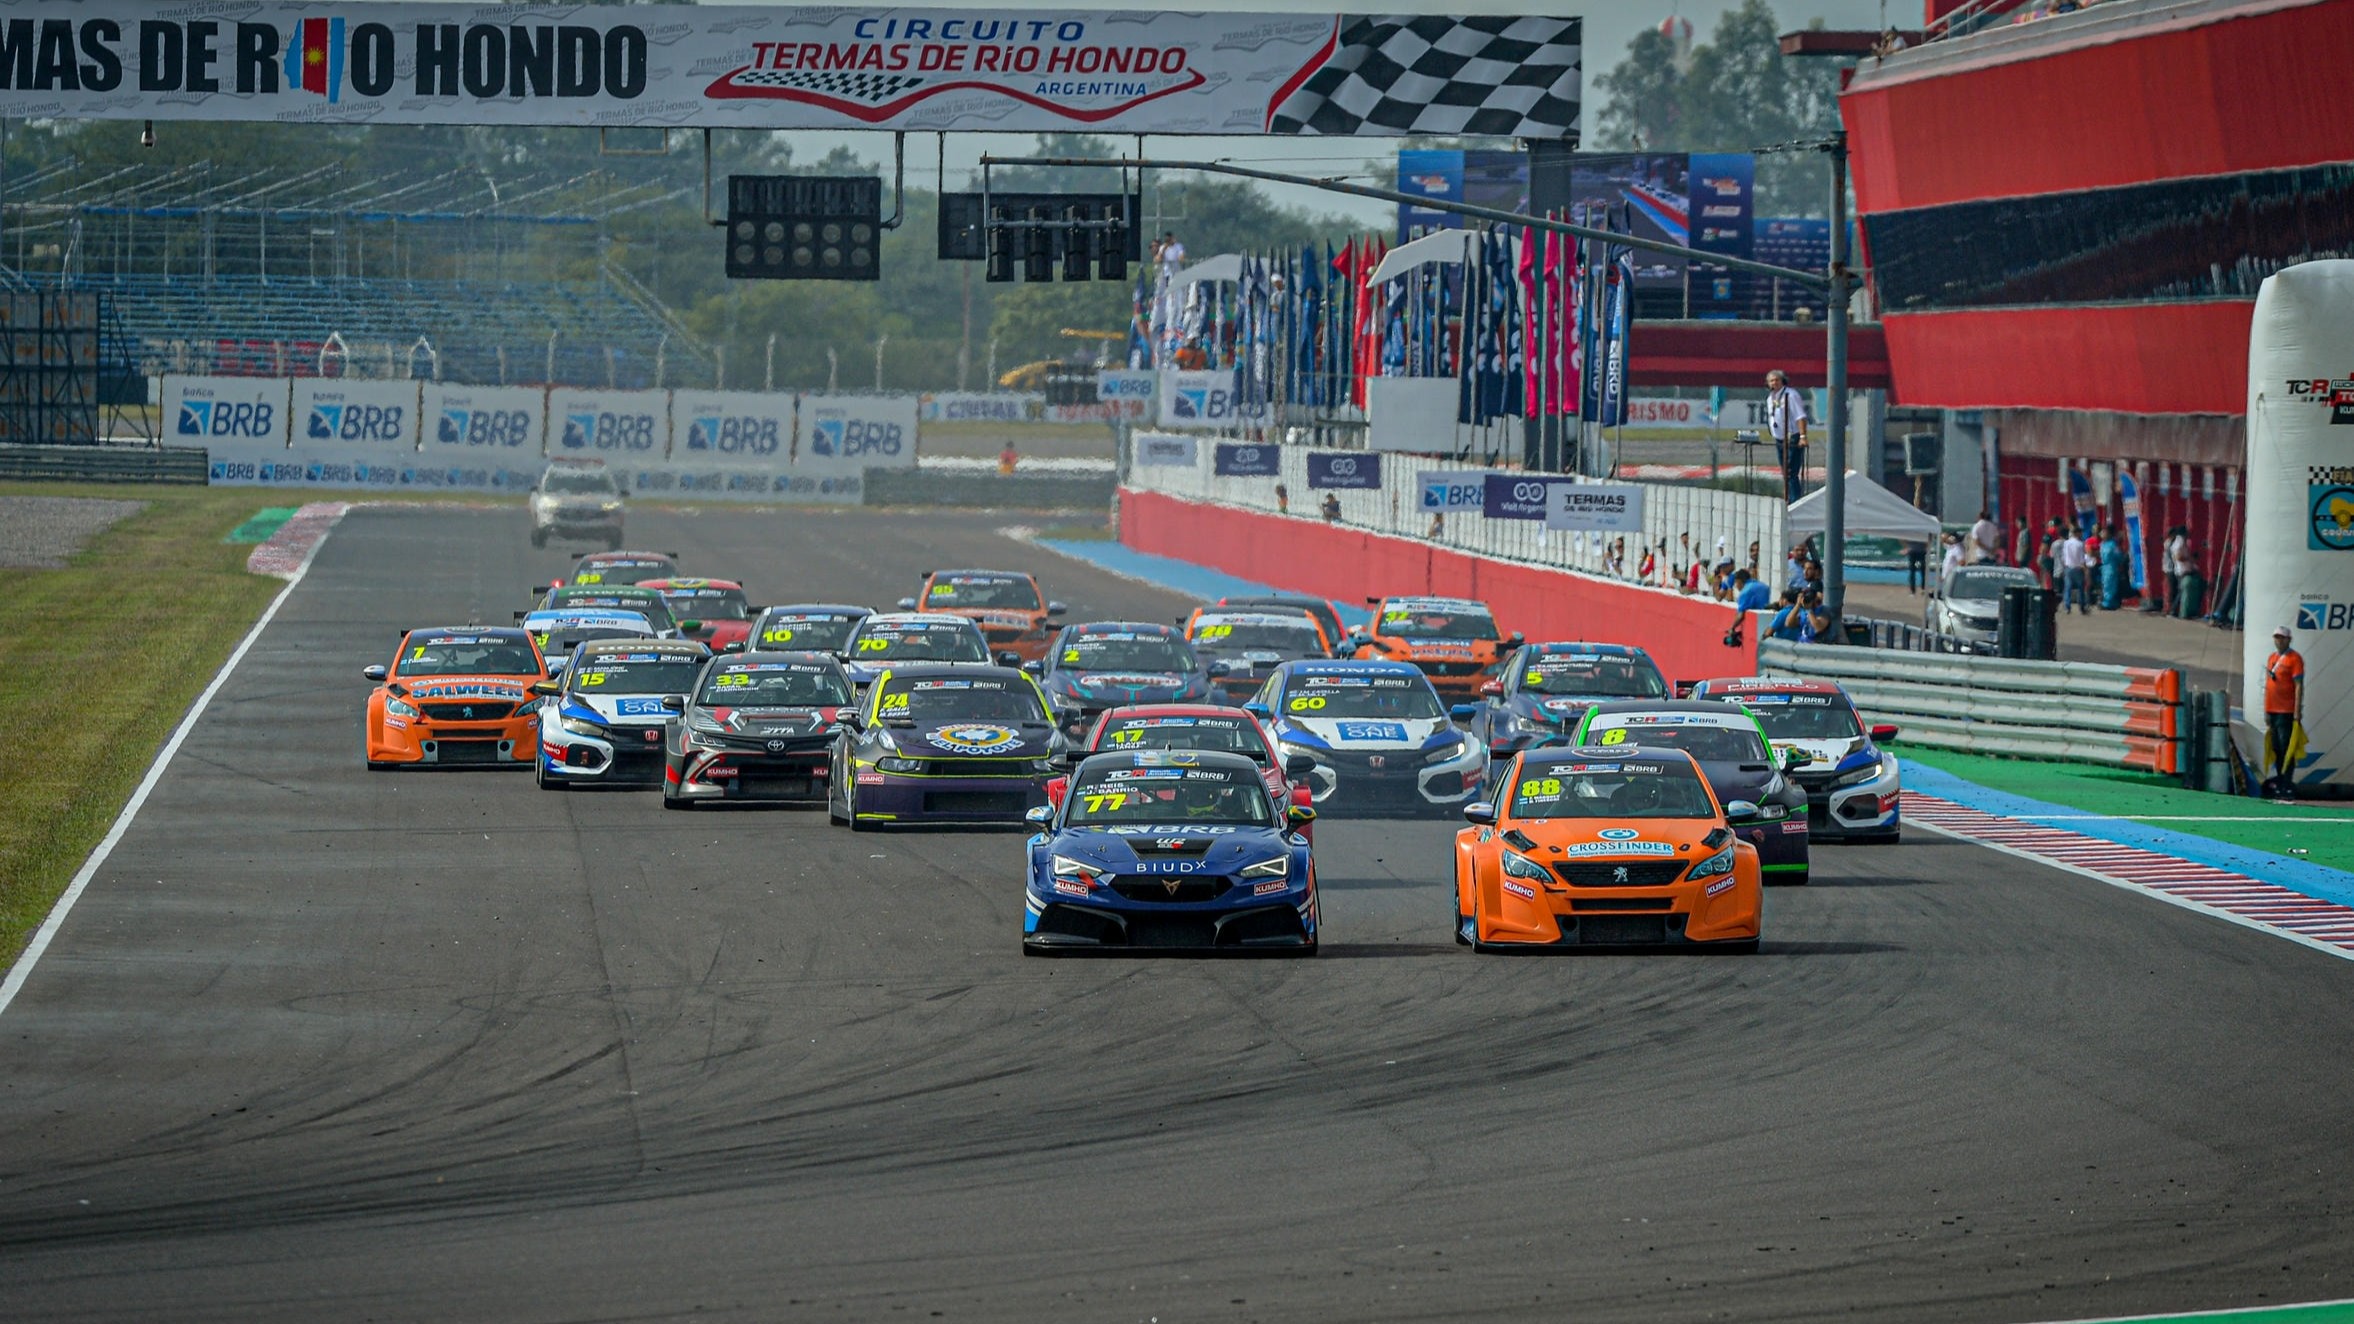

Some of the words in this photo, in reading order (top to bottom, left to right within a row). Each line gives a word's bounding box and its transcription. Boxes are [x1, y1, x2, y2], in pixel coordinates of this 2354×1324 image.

[854, 18, 1085, 41] CIRCUITO
[139, 19, 219, 93] DE
[416, 23, 648, 99] HONDO
[751, 42, 911, 72] TERMAS
[916, 44, 969, 73] DE
[1046, 46, 1187, 75] HONDO
[1034, 80, 1148, 97] ARGENTINA
[2286, 379, 2330, 395] TCR
[211, 402, 275, 437] BRB
[340, 404, 403, 441] BRB
[466, 408, 531, 447] BRB
[595, 411, 656, 450] BRB
[718, 415, 780, 455] BRB
[842, 418, 903, 458] BRB
[225, 463, 255, 480] BRB
[1564, 493, 1627, 507] TERMAS
[762, 630, 793, 643] 10
[857, 639, 889, 652] 70
[1063, 649, 1080, 663] 2
[580, 672, 606, 687] 15
[715, 673, 750, 687] 33
[1526, 671, 1543, 685] 5
[882, 692, 909, 709] 24
[1290, 696, 1327, 711] 60
[1110, 728, 1145, 744] 17
[1601, 728, 1628, 746] 8
[706, 768, 738, 776] KUMHO
[857, 775, 884, 783] KUMHO
[1200, 771, 1225, 780] BRB
[1521, 777, 1561, 798] 88
[1083, 792, 1128, 814] 77
[1152, 824, 1236, 835] BRB
[1568, 841, 1673, 853] CROSSFINDER
[1056, 880, 1088, 895] KUMHO
[1255, 881, 1286, 894] KUMHO
[1503, 880, 1534, 899] KUMHO
[1706, 876, 1735, 896] KUMHO
